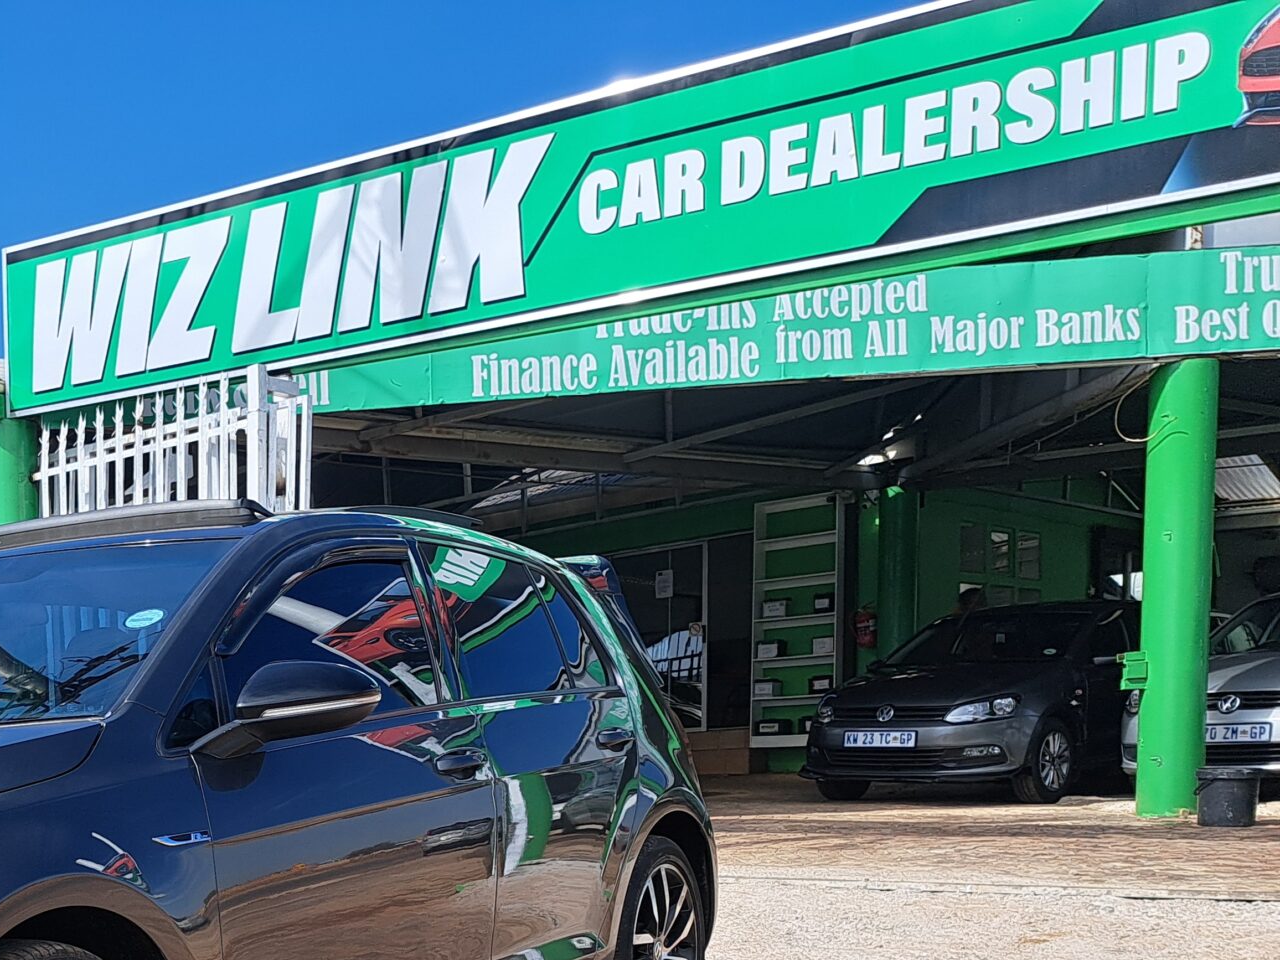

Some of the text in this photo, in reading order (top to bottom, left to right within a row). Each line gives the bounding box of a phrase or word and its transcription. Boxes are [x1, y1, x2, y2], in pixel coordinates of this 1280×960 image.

[579, 31, 1211, 235] CAR DEALERSHIP
[33, 132, 556, 394] WIZ LINK
[773, 274, 928, 322] Accepted
[1174, 302, 1250, 344] Best
[471, 304, 1141, 397] Finance Available from All Major Banks
[862, 733, 875, 745] 23
[880, 733, 891, 745] TC
[900, 733, 913, 745] GP
[1250, 726, 1267, 739] GP
